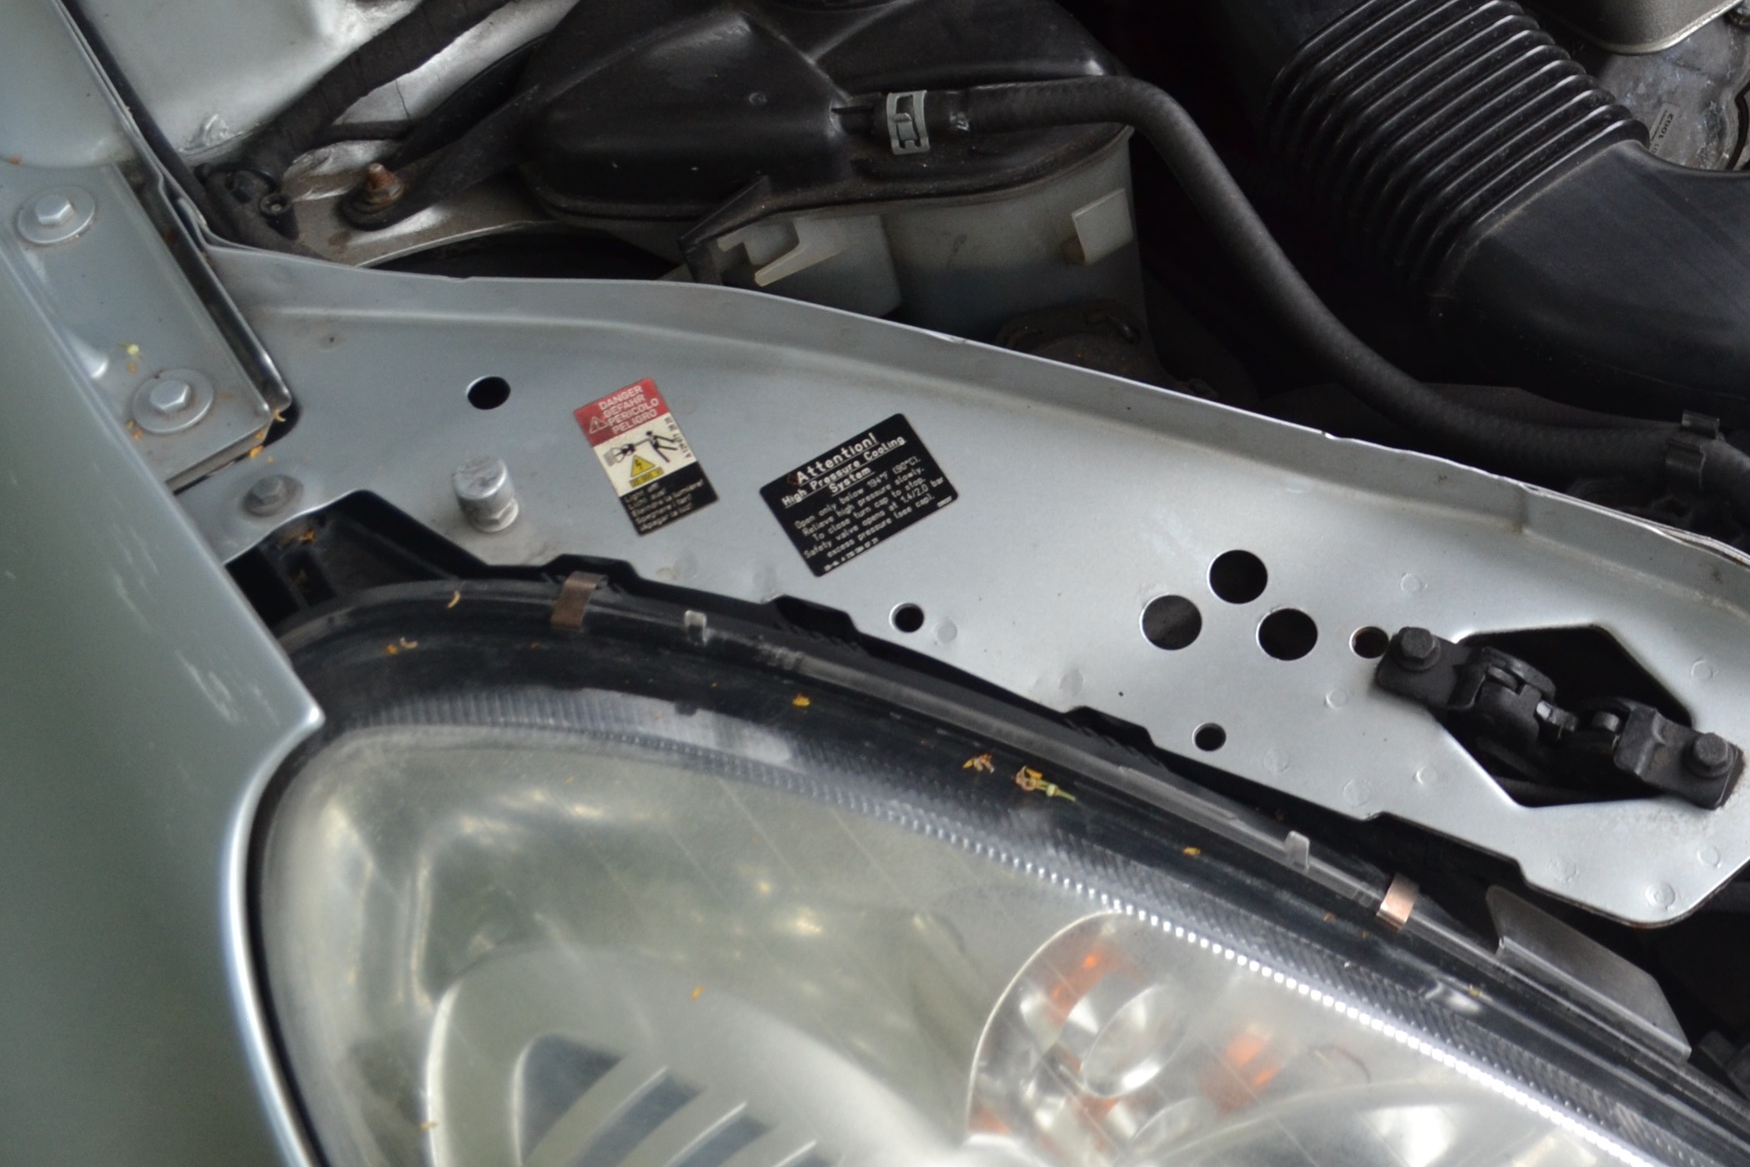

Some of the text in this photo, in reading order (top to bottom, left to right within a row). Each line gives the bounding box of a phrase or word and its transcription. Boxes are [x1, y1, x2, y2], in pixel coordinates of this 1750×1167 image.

[1658, 113, 1674, 139] 1002
[598, 385, 644, 410] DANGER
[603, 394, 646, 418] GEFAHR
[607, 397, 660, 427] PERICOLO
[612, 409, 658, 435] PELIGRO
[781, 435, 906, 506] High Pressure Cooling
[796, 432, 878, 484] Attention!
[830, 466, 872, 494] System
[794, 513, 816, 529] Open
[818, 502, 837, 516] only
[838, 487, 864, 505] below
[802, 466, 925, 536] Relieve high pressure slowly.
[803, 540, 832, 559] Safety
[836, 523, 859, 540] valve
[861, 509, 886, 527] opens
[888, 501, 898, 511] at
[899, 485, 929, 504] 1.4/2.0
[930, 476, 945, 488] bar
[813, 477, 927, 542] To close turn cap to stop.
[826, 540, 855, 558] excess
[857, 517, 892, 541] pressure
